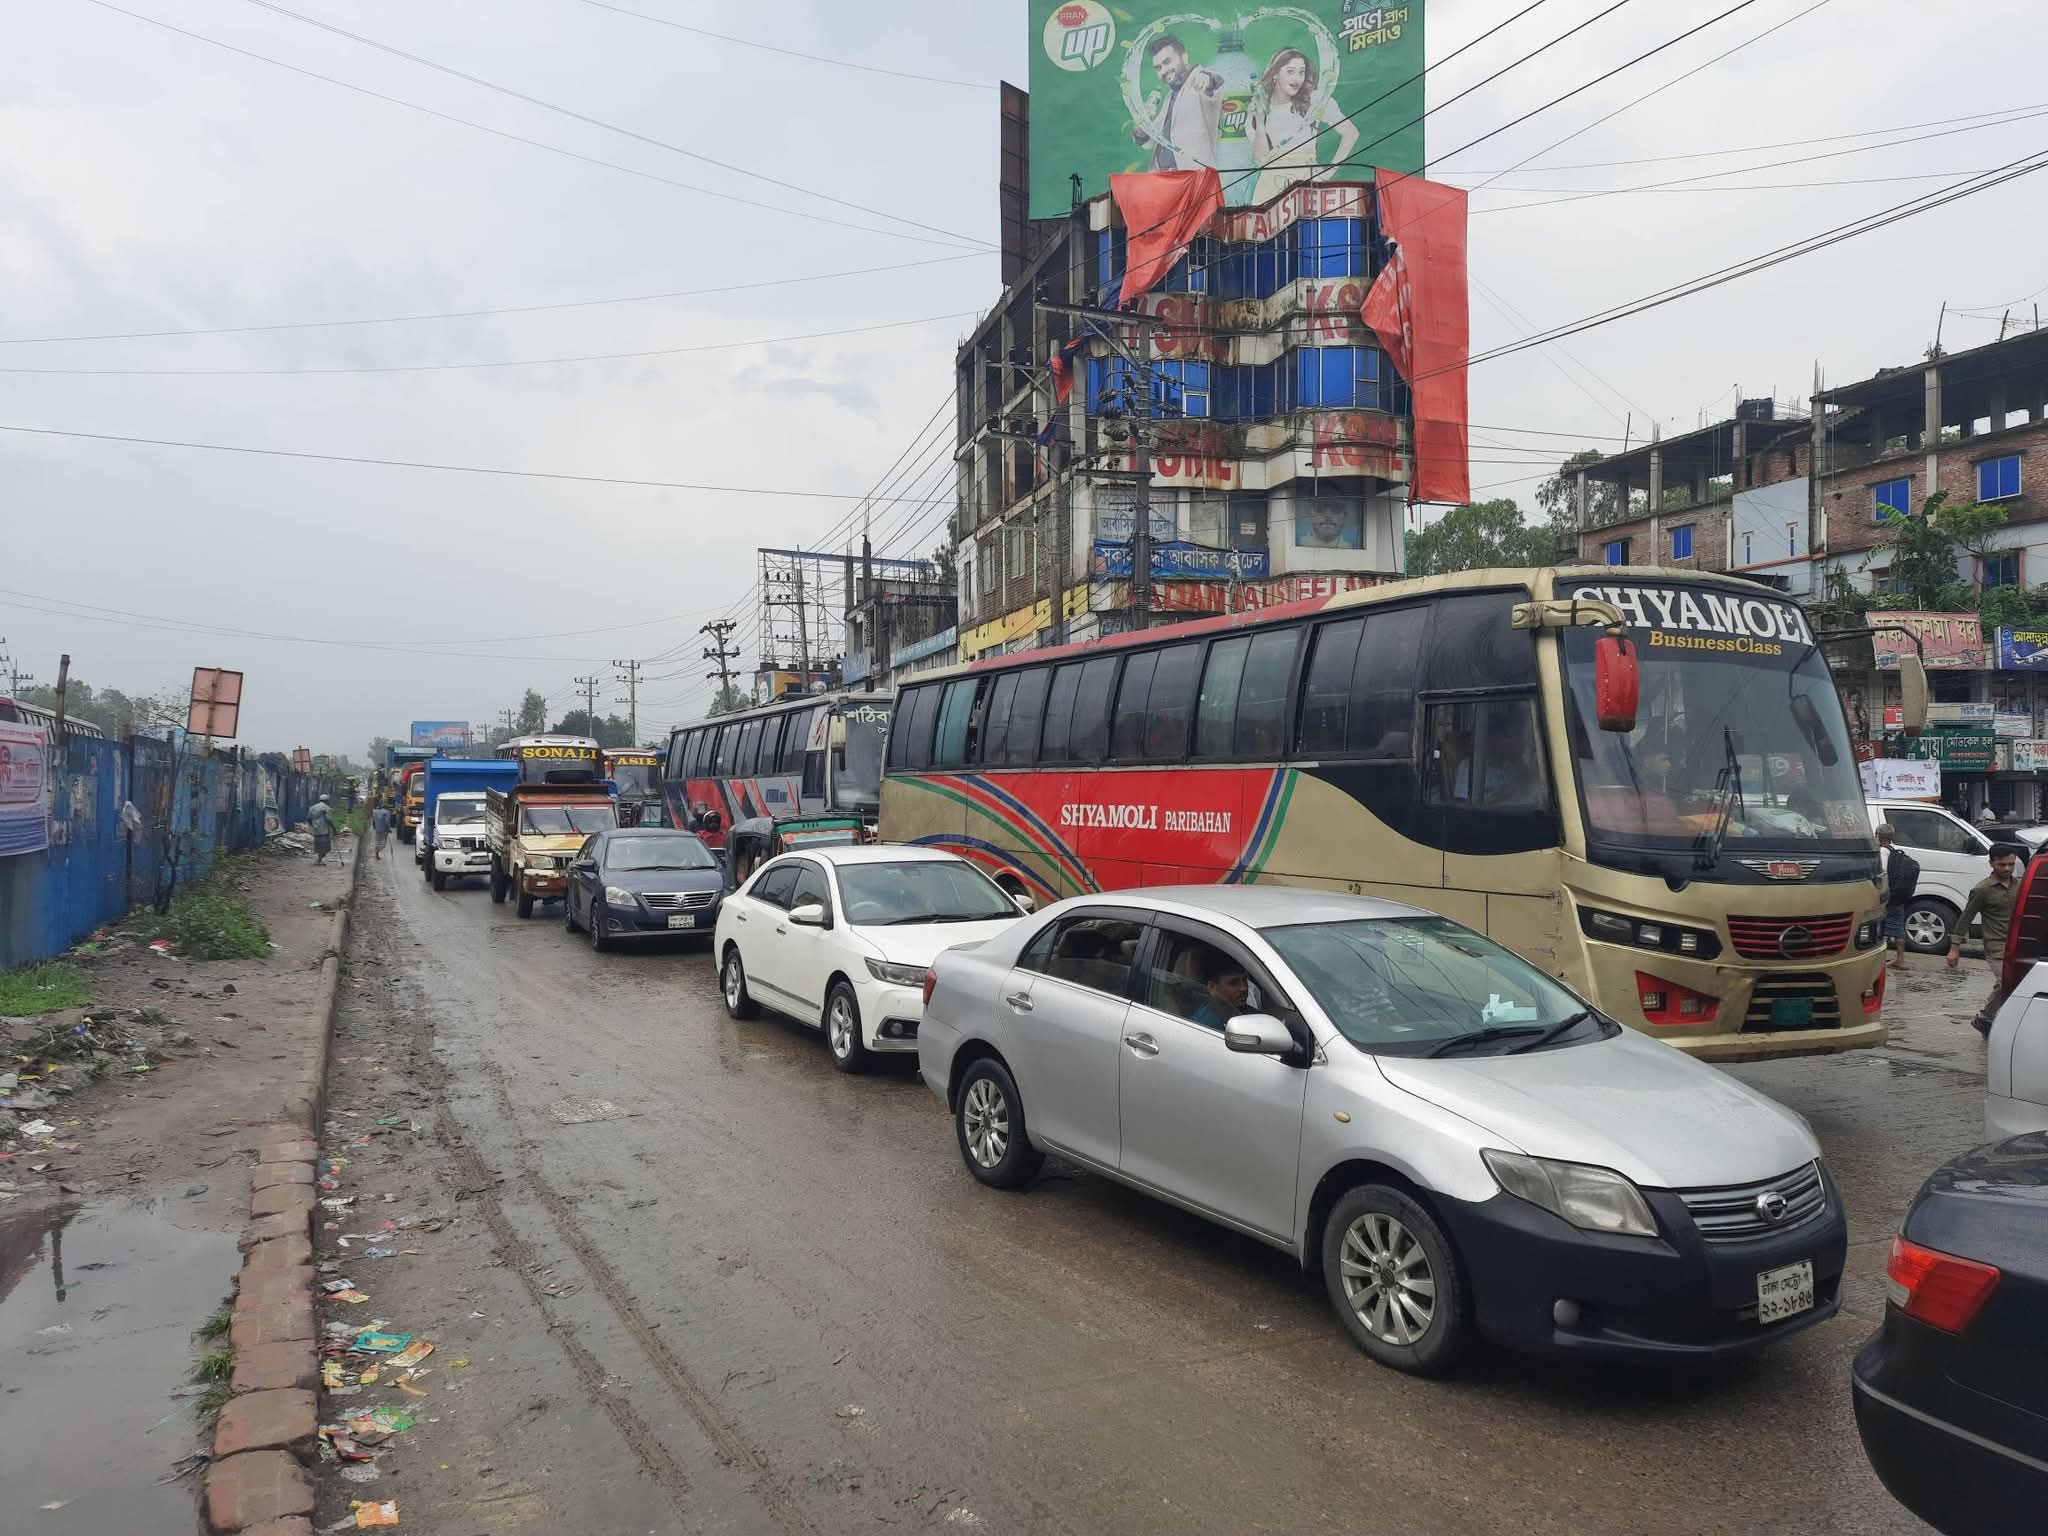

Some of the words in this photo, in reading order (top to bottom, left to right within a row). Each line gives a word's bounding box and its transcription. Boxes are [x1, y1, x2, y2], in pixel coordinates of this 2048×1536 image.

[1059, 11, 1085, 20] PRAN
[1338, 8, 1382, 38] প্রাণে
[1382, 7, 1408, 27] প্রাণ
[1349, 24, 1401, 52] মিলাও
[522, 747, 598, 760] SONALI
[1060, 804, 1158, 830] SHYAMOLI
[1164, 811, 1231, 834] PARIBAHAN
